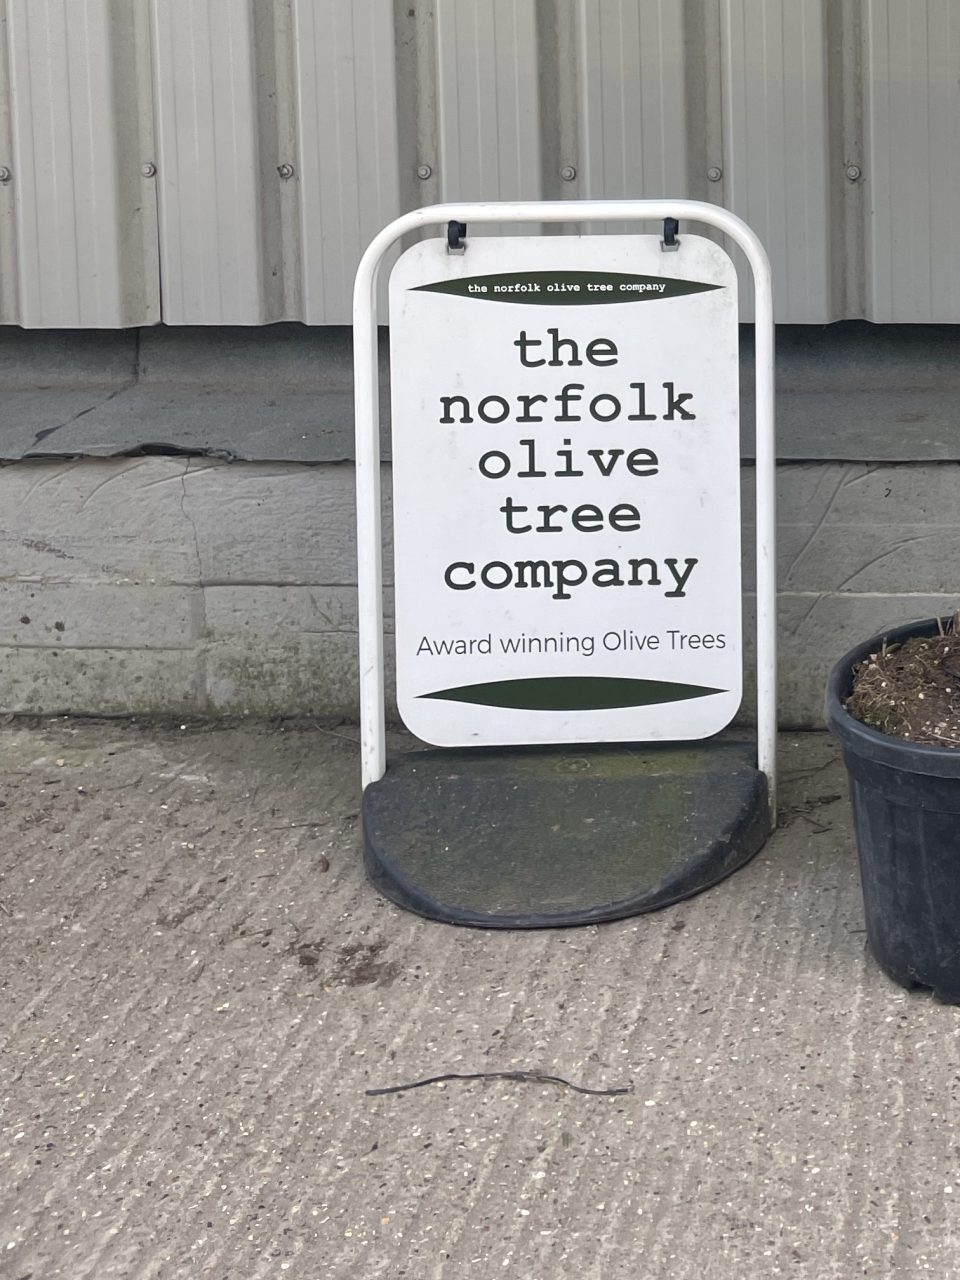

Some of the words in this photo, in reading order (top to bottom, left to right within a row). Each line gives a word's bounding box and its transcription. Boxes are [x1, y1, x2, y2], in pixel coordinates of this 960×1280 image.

[467, 283, 488, 293] the
[493, 283, 541, 293] norfolk
[546, 283, 581, 292] olive
[586, 283, 614, 292] tree
[619, 282, 667, 293] company
[514, 328, 618, 368] the
[439, 382, 696, 424] norfolk
[478, 438, 659, 479] olive
[500, 496, 641, 534] tree
[444, 558, 699, 600] company
[416, 634, 492, 656] Award
[500, 631, 595, 657] winning
[603, 629, 660, 651] Olive
[667, 629, 726, 651] Trees
